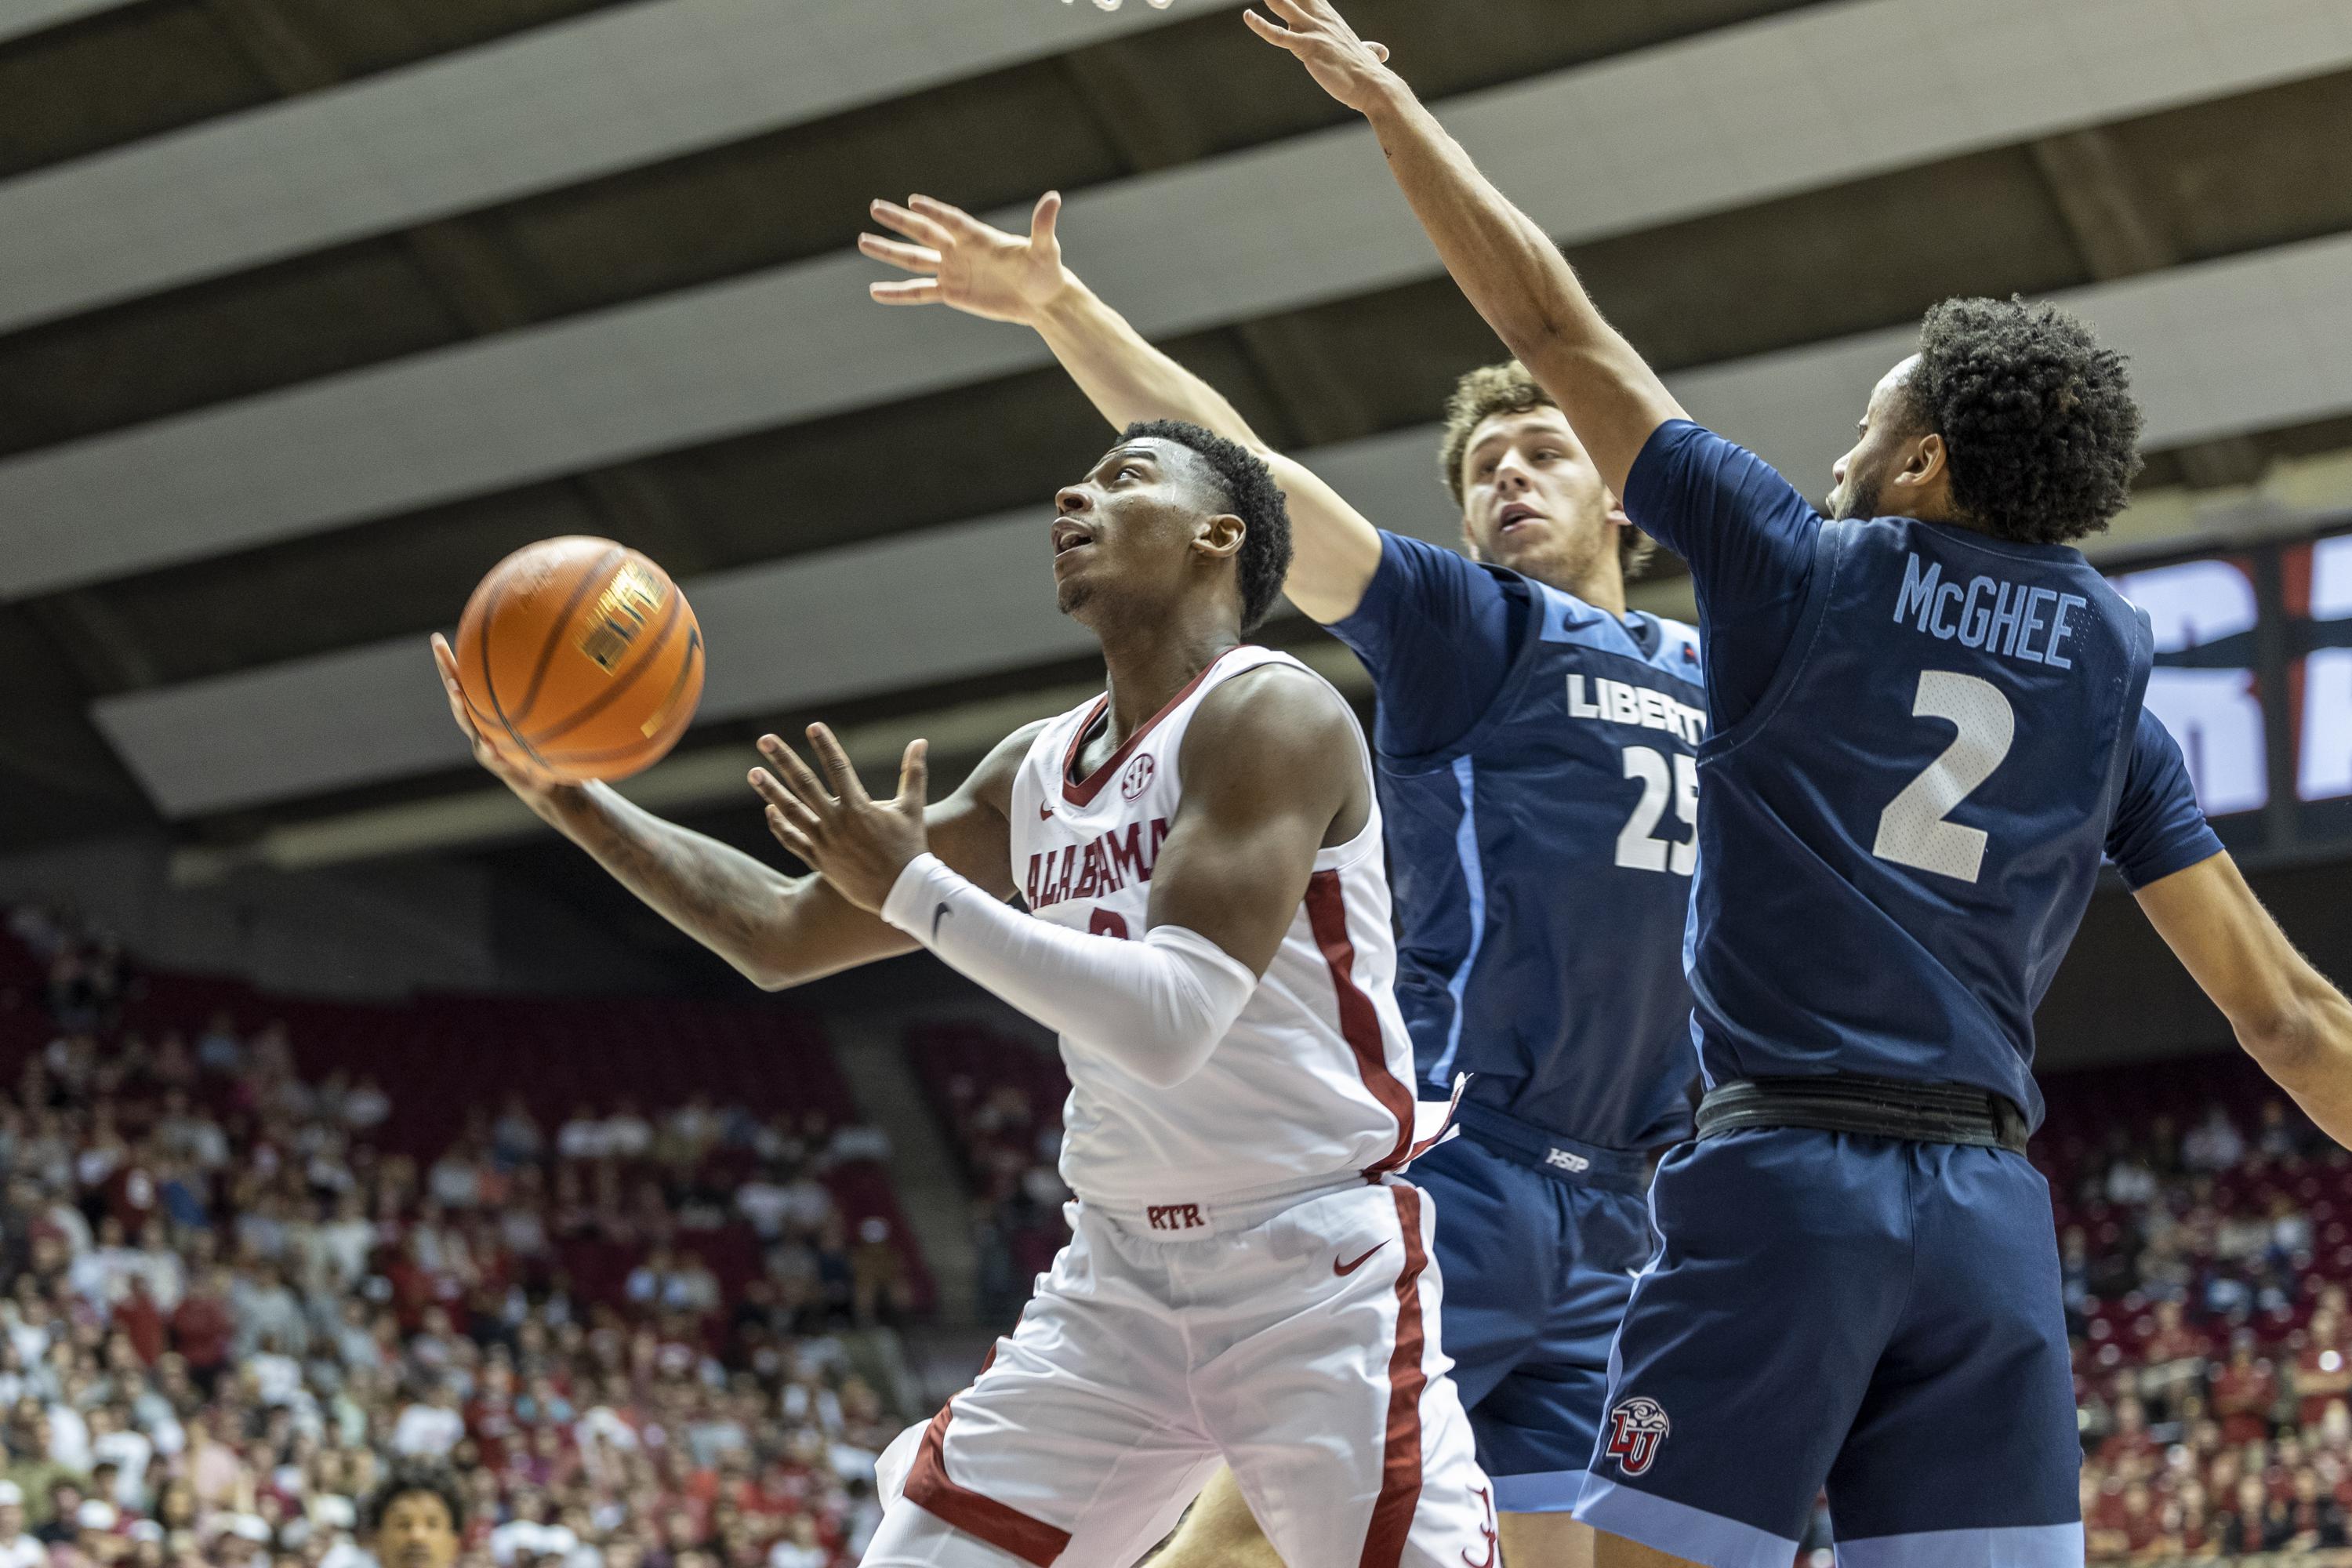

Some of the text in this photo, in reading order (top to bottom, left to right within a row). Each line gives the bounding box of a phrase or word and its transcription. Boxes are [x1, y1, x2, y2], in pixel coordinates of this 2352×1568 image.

[1893, 552, 2086, 669] McGHEE
[1566, 674, 1706, 746] LIBERT
[1614, 745, 1699, 877] 25
[1872, 670, 2015, 884] 2
[1147, 1203, 1205, 1230] RTR
[1606, 1409, 1662, 1475] LU
